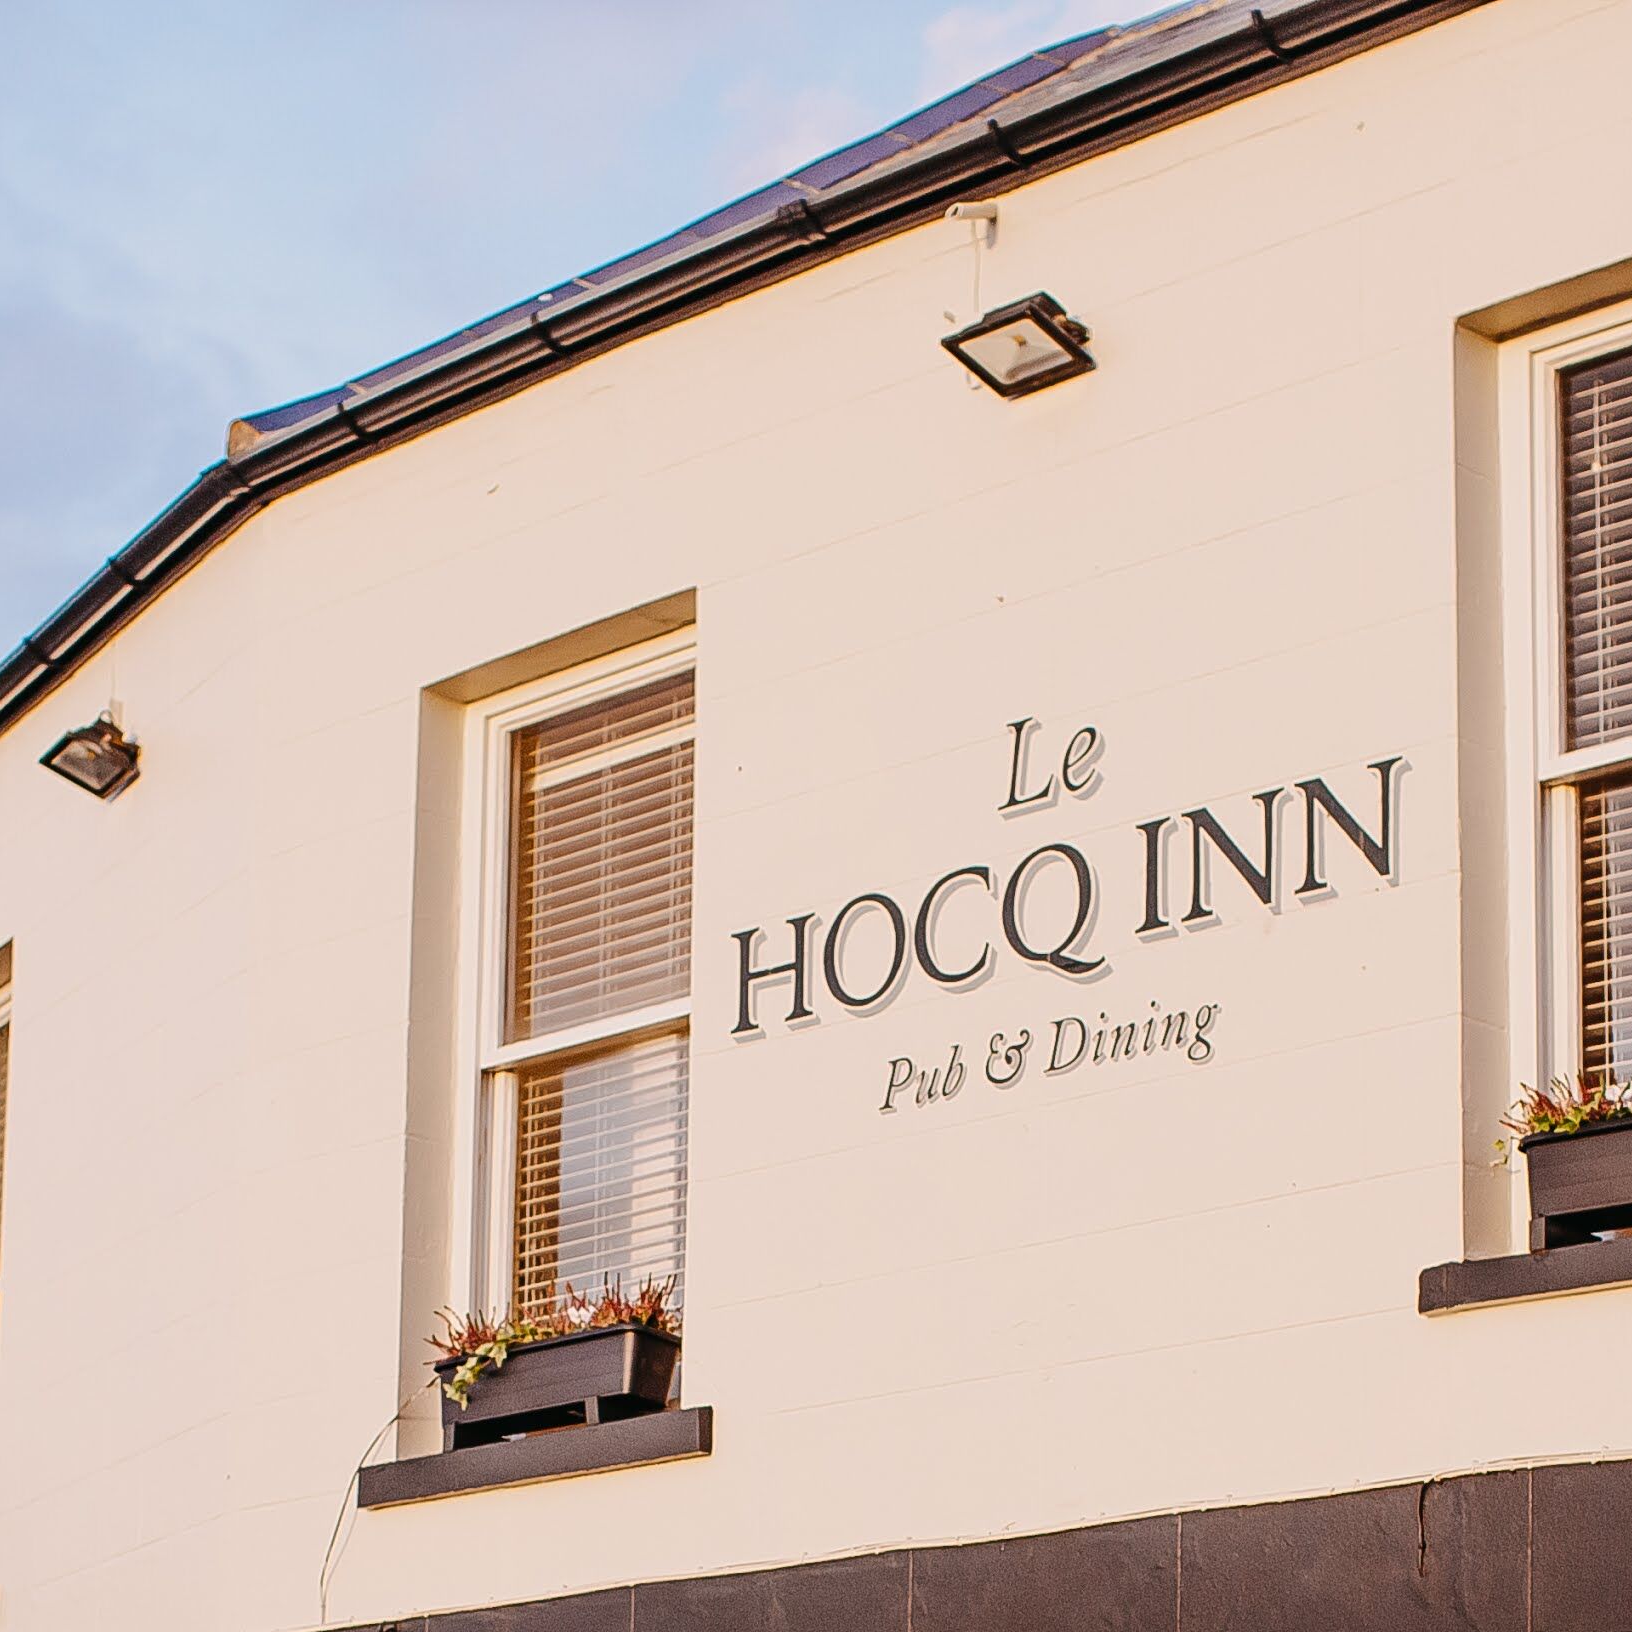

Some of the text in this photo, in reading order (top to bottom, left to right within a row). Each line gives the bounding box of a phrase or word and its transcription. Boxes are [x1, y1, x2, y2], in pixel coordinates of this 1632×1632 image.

[997, 716, 1099, 812] Le
[729, 755, 1405, 1036] HOCQ INN
[878, 1002, 1220, 1112] Pub & Dining
